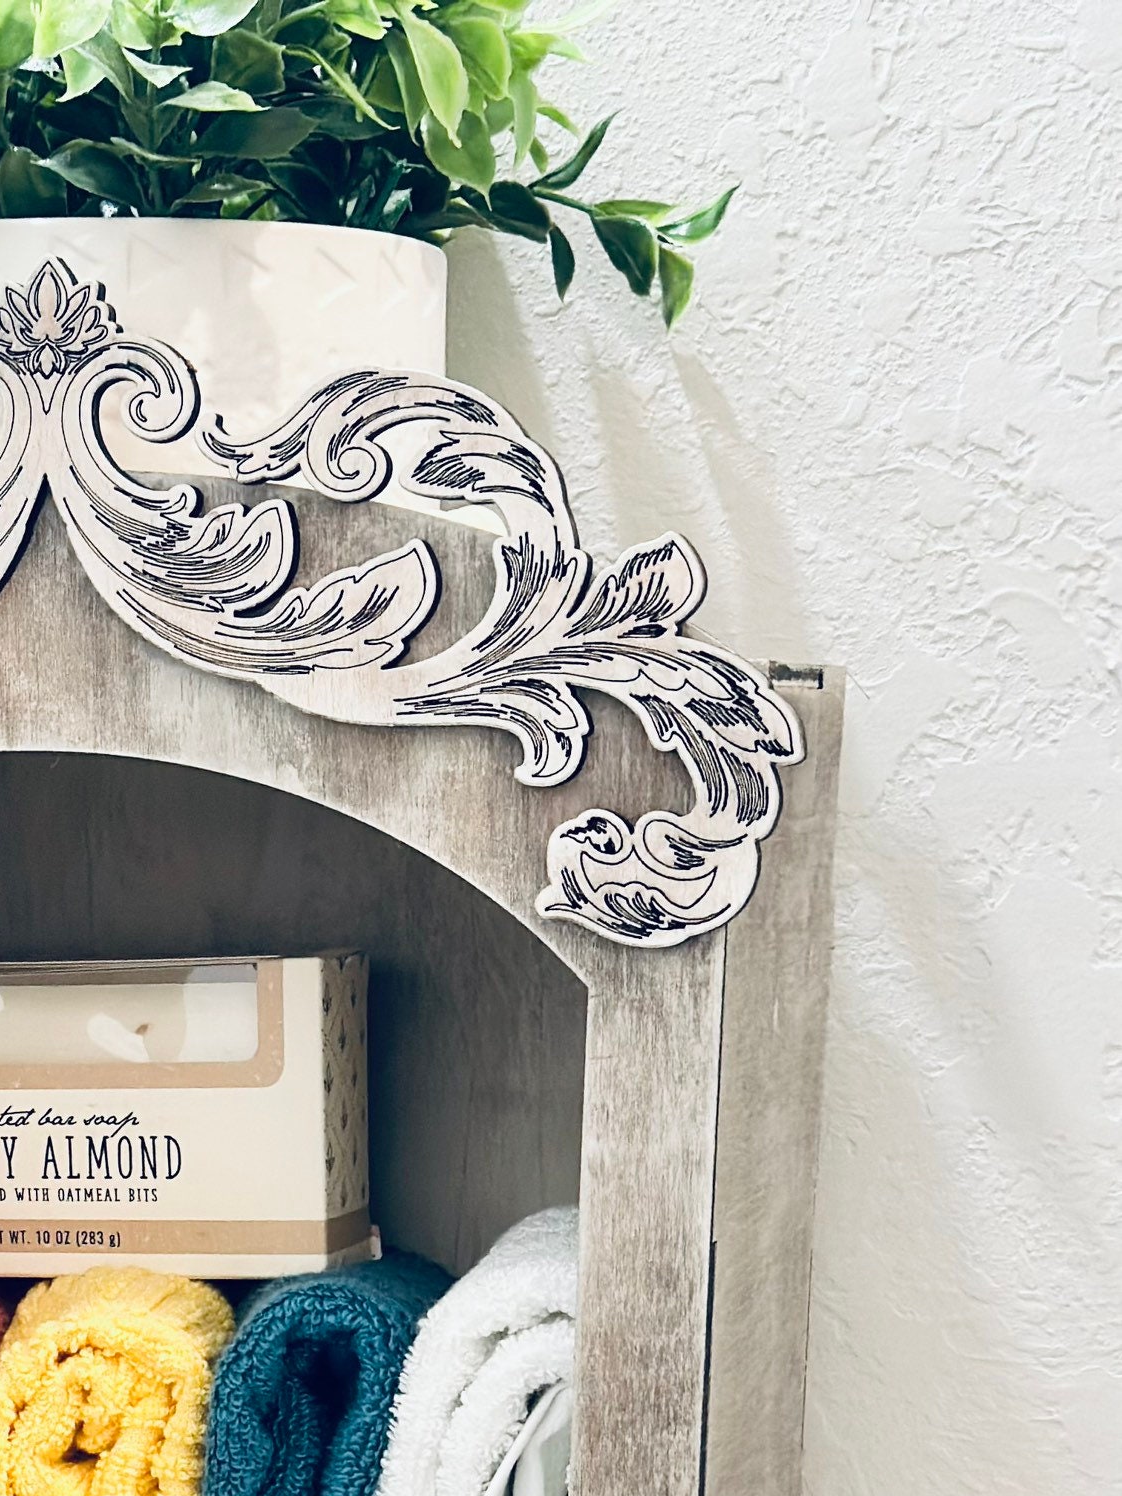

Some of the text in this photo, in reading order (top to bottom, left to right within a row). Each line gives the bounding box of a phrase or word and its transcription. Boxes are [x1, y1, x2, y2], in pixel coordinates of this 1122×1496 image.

[37, 1108, 78, 1126] bar
[83, 1112, 140, 1138] soap
[41, 1135, 182, 1180] ALMOND
[14, 1187, 50, 1202] WITH
[57, 1187, 121, 1203] OATMEAL
[129, 1187, 158, 1203] BITS
[9, 1229, 31, 1245] WT.
[35, 1230, 51, 1246] 10
[55, 1230, 72, 1246] OZ
[75, 1230, 104, 1248] (283
[108, 1231, 121, 1248] g)
